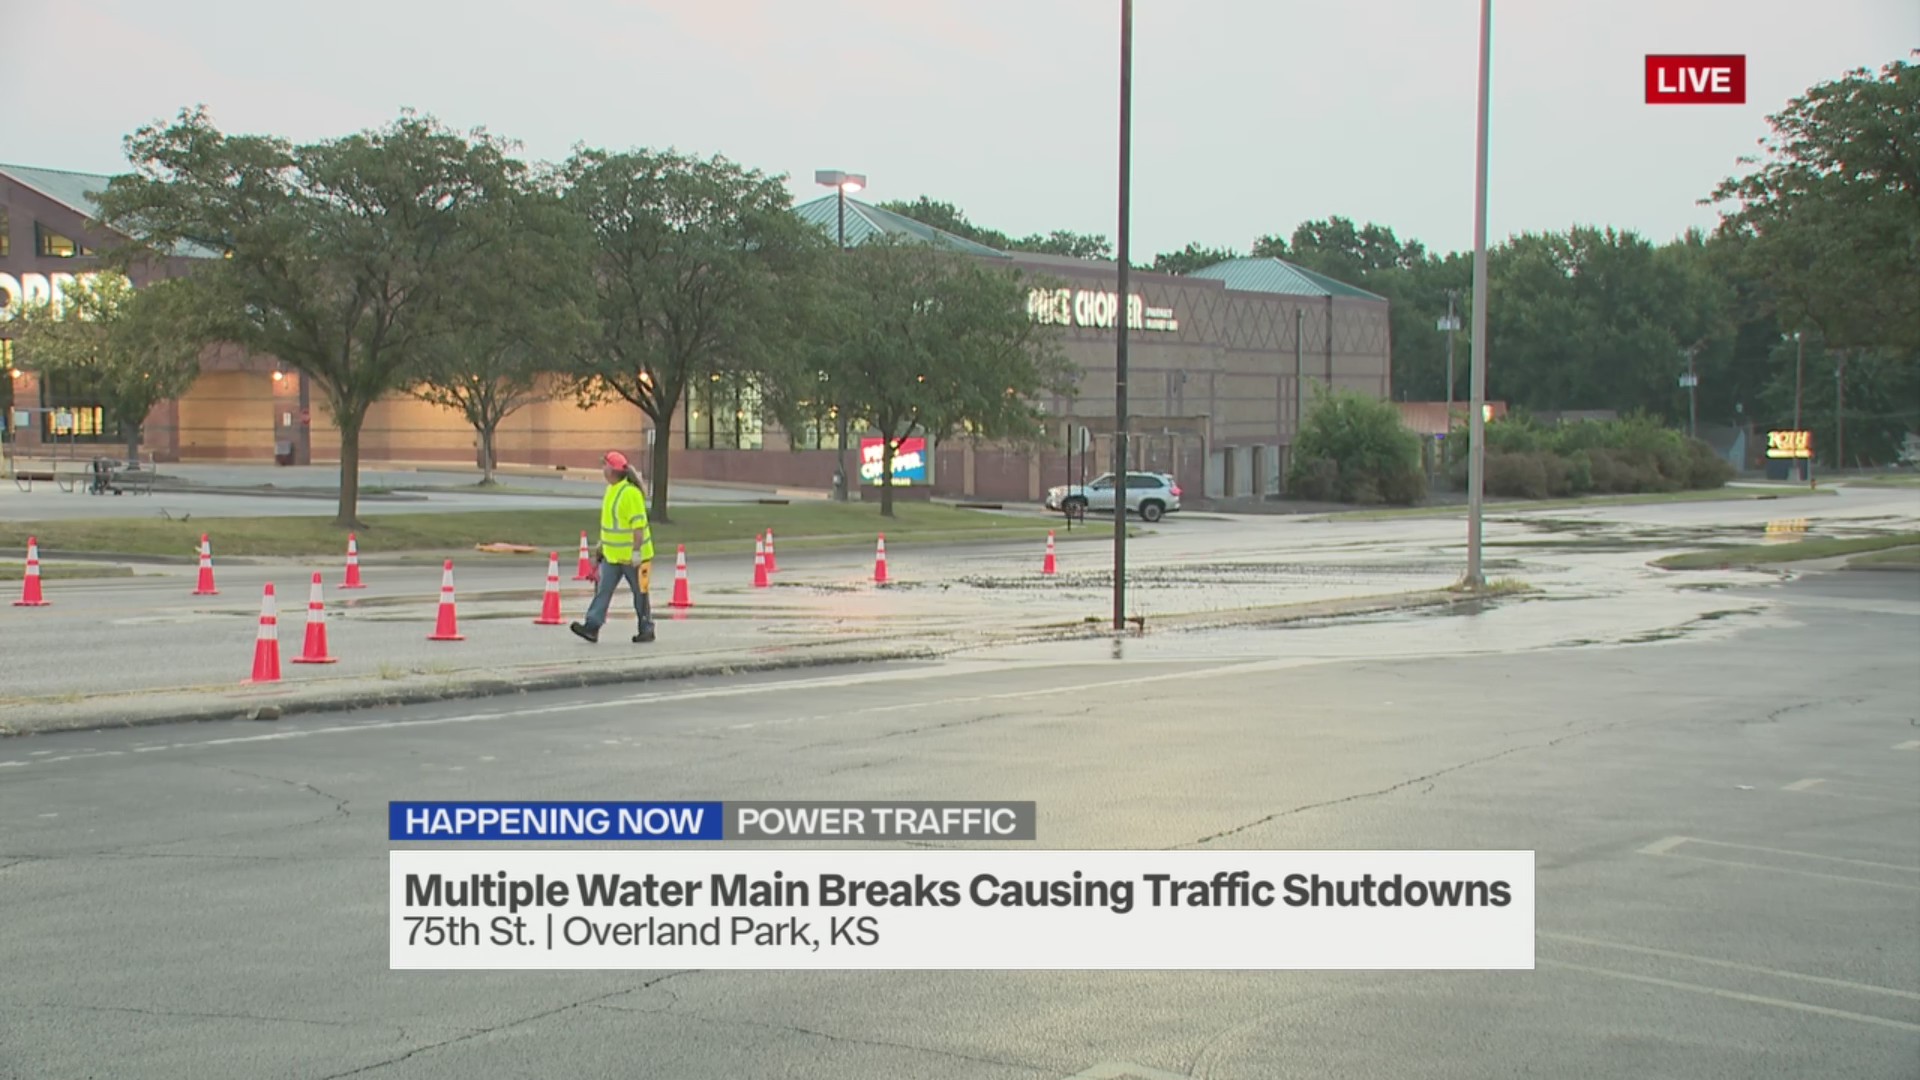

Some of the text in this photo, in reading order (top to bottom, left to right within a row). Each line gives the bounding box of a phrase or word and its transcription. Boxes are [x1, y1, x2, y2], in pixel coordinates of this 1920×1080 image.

[0, 272, 133, 322] OPPE
[1028, 287, 1143, 329] PRICE CHOPER
